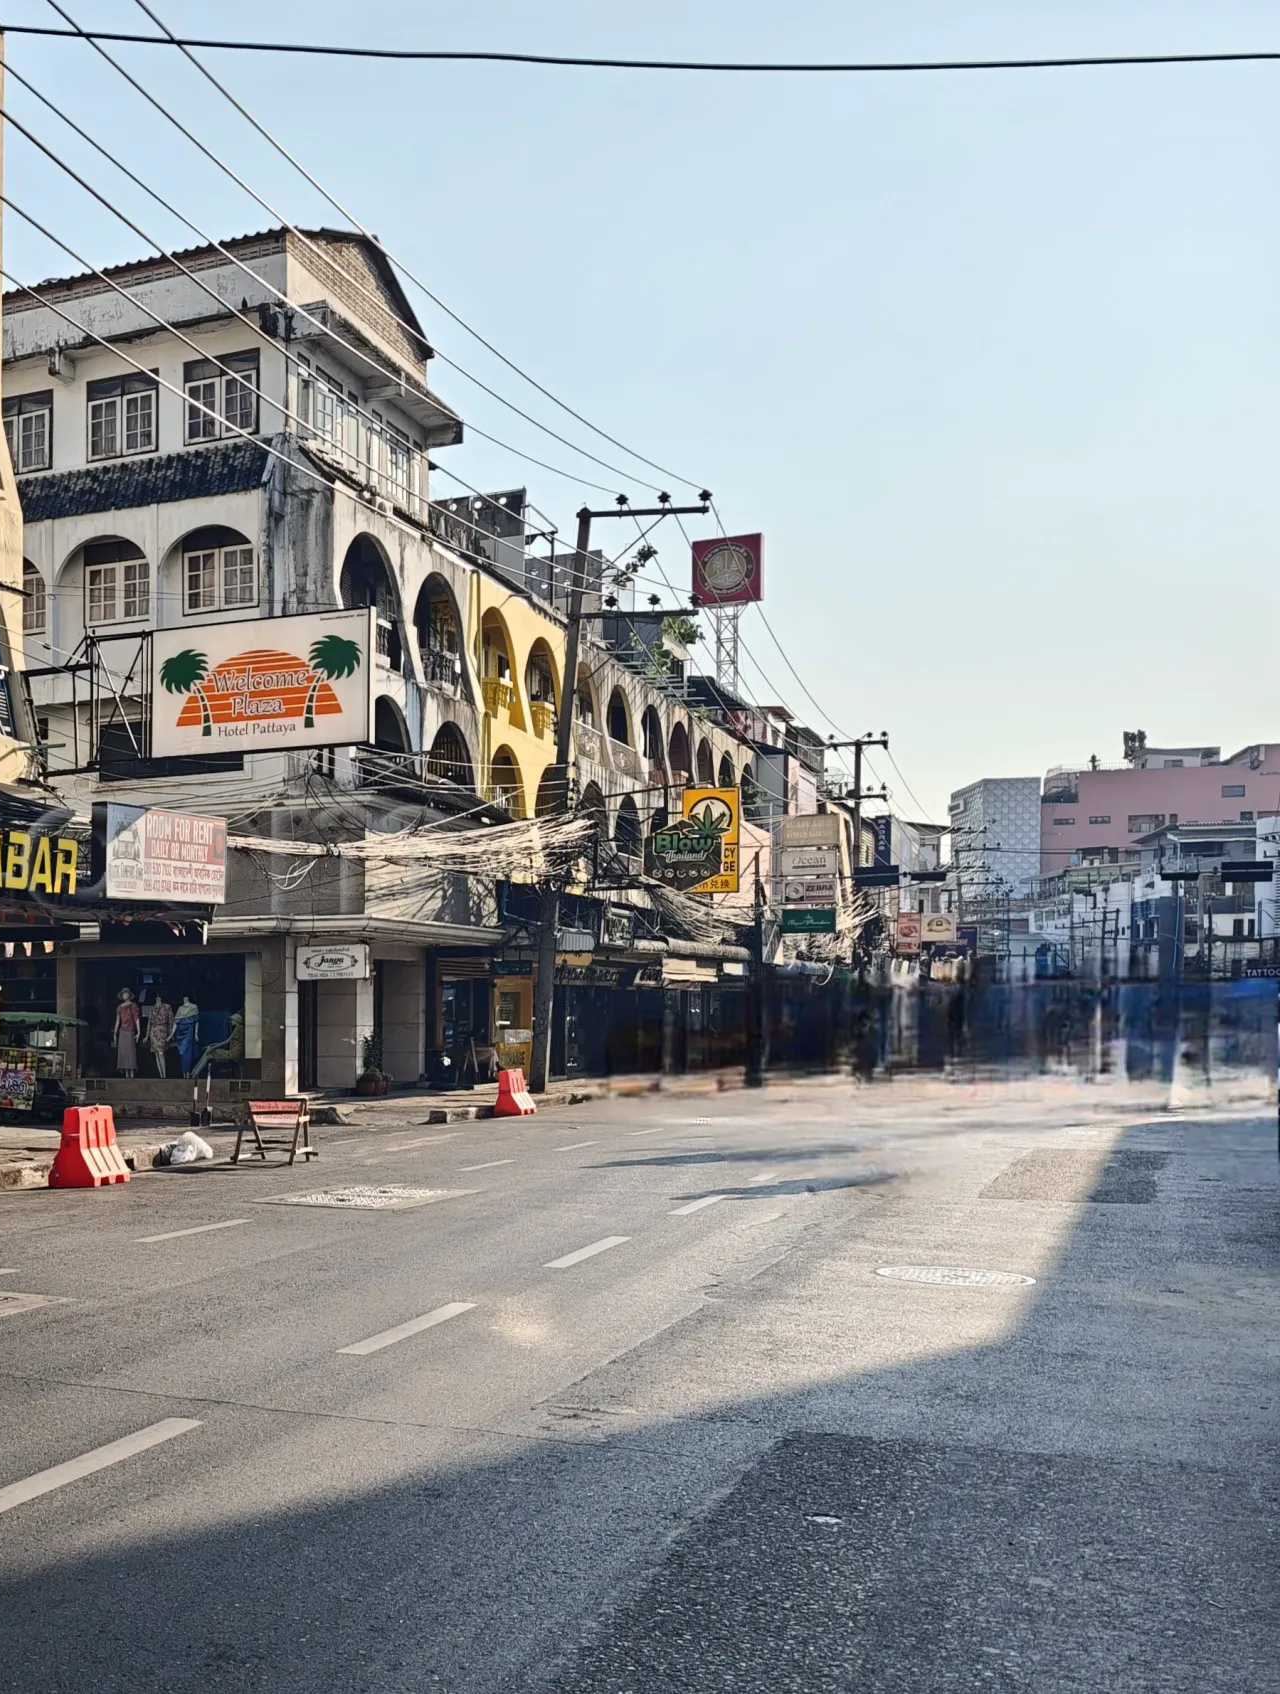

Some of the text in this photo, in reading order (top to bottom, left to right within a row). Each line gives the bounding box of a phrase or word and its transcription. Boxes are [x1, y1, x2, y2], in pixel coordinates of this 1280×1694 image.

[212, 667, 307, 693] Welcome
[231, 694, 284, 716] Plaza
[218, 721, 296, 737] Hotel Pattaya
[146, 814, 214, 845] ROOM FOR RENT
[151, 840, 209, 862] DAILY OR MONTHLY
[656, 834, 712, 852] Blow
[664, 850, 705, 863] Thailand
[805, 884, 834, 892] ZEBRA
